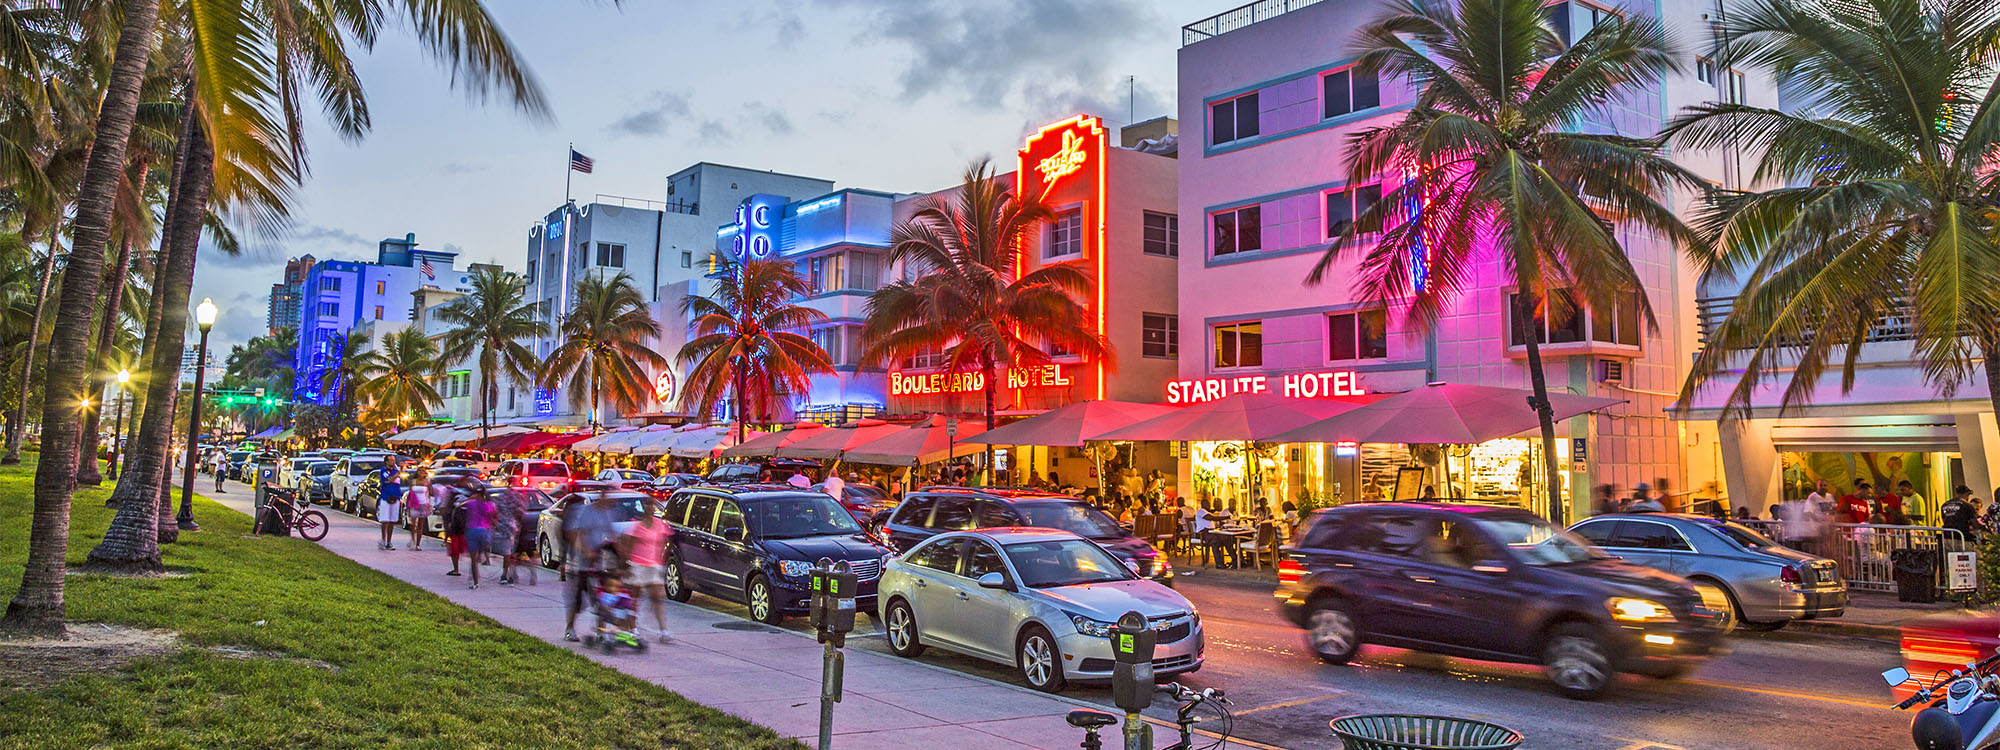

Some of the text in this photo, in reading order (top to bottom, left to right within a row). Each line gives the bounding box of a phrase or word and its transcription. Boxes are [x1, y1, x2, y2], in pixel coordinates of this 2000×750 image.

[891, 364, 1070, 395] BOULEVARD HOTEL
[1284, 371, 1366, 398] HOTEL
